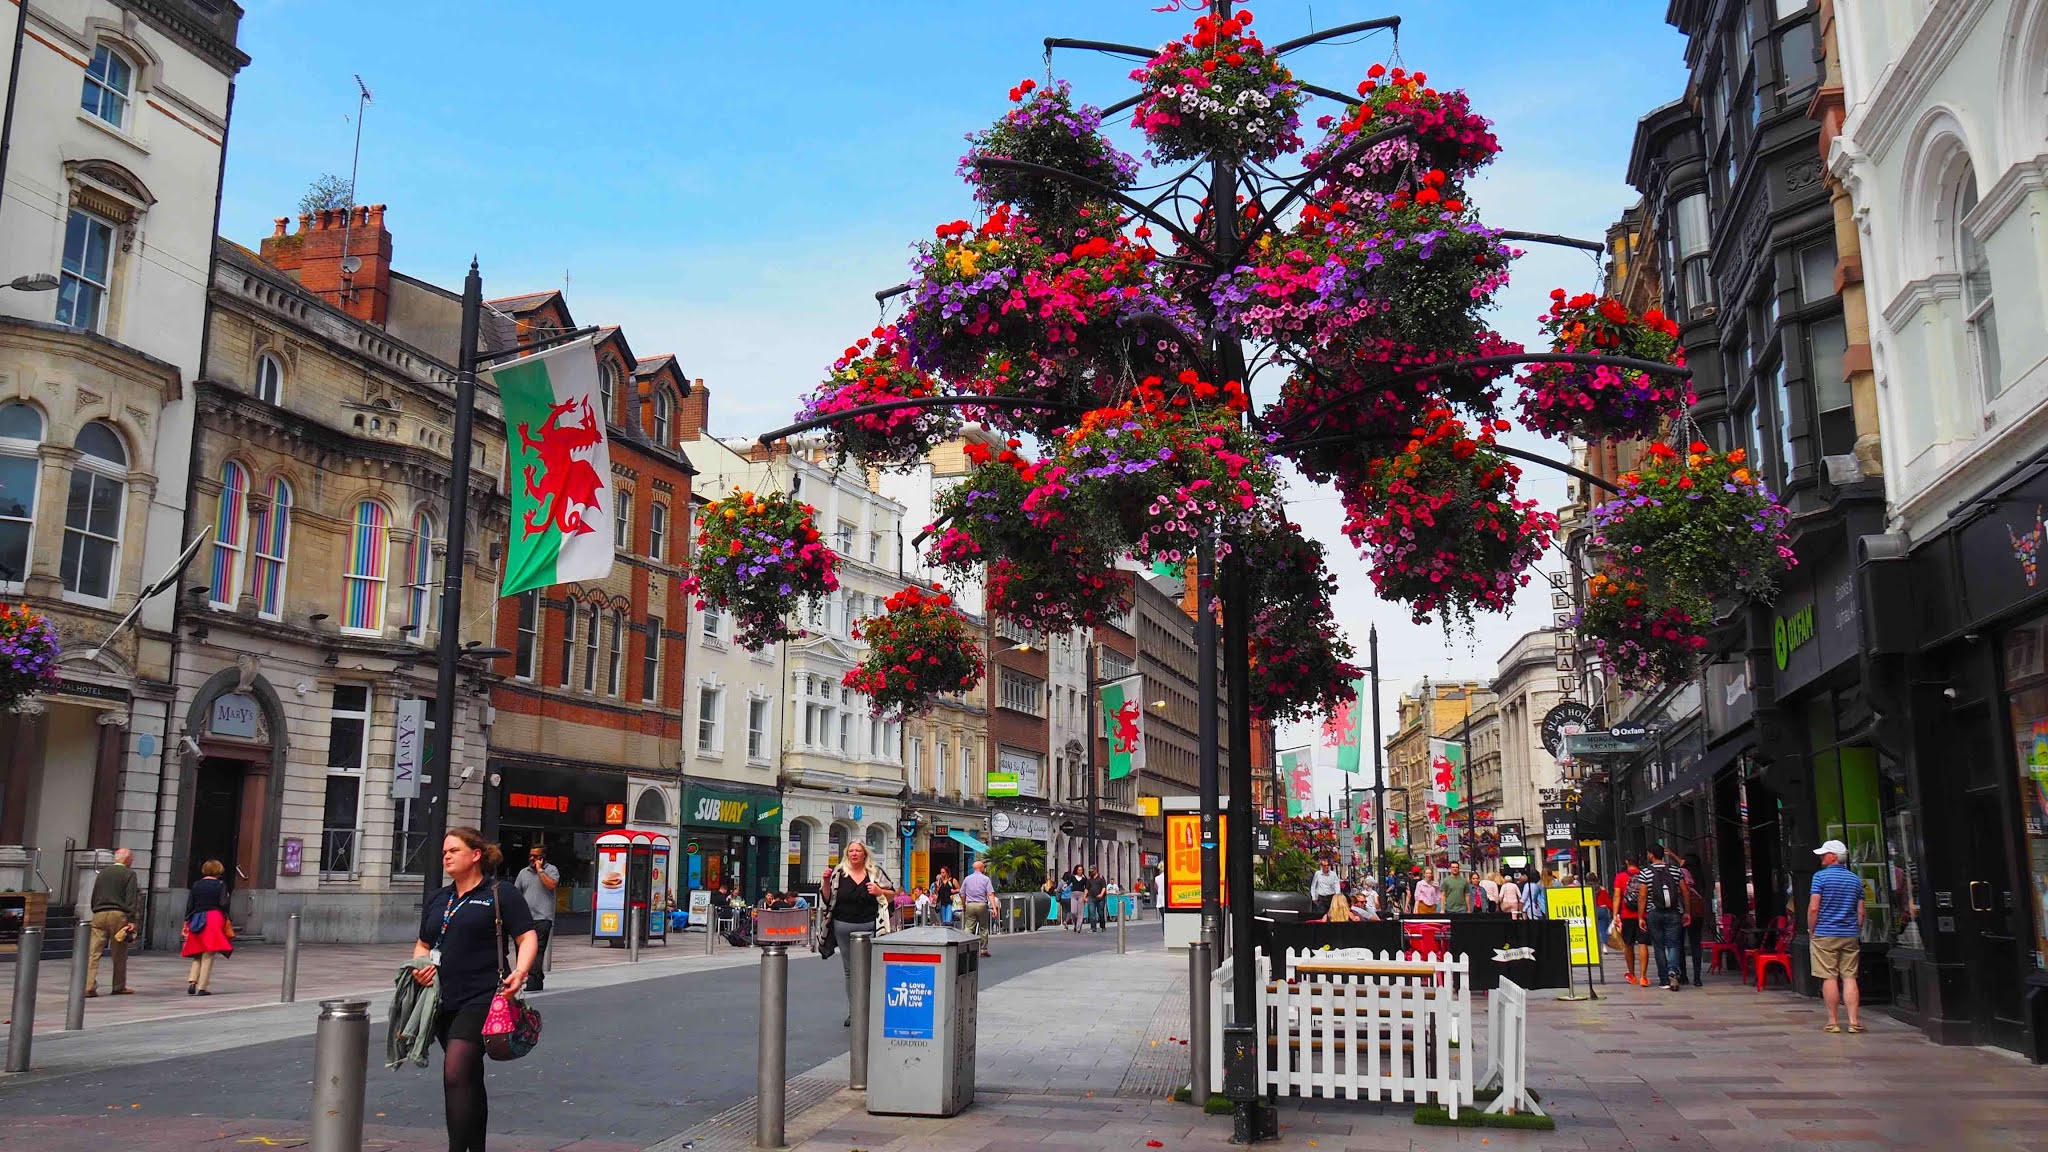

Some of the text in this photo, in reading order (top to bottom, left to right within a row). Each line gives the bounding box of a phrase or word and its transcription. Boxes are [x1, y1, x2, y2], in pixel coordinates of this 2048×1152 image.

[1787, 603, 1814, 652] OXFAM
[76, 685, 103, 695] HOTEL
[1547, 708, 1596, 731] PLAY HOUSE
[1620, 727, 1645, 735] Oxfam
[694, 797, 748, 823] SUBWAY
[757, 806, 780, 821] SUBWAY
[1546, 828, 1571, 836] PIES
